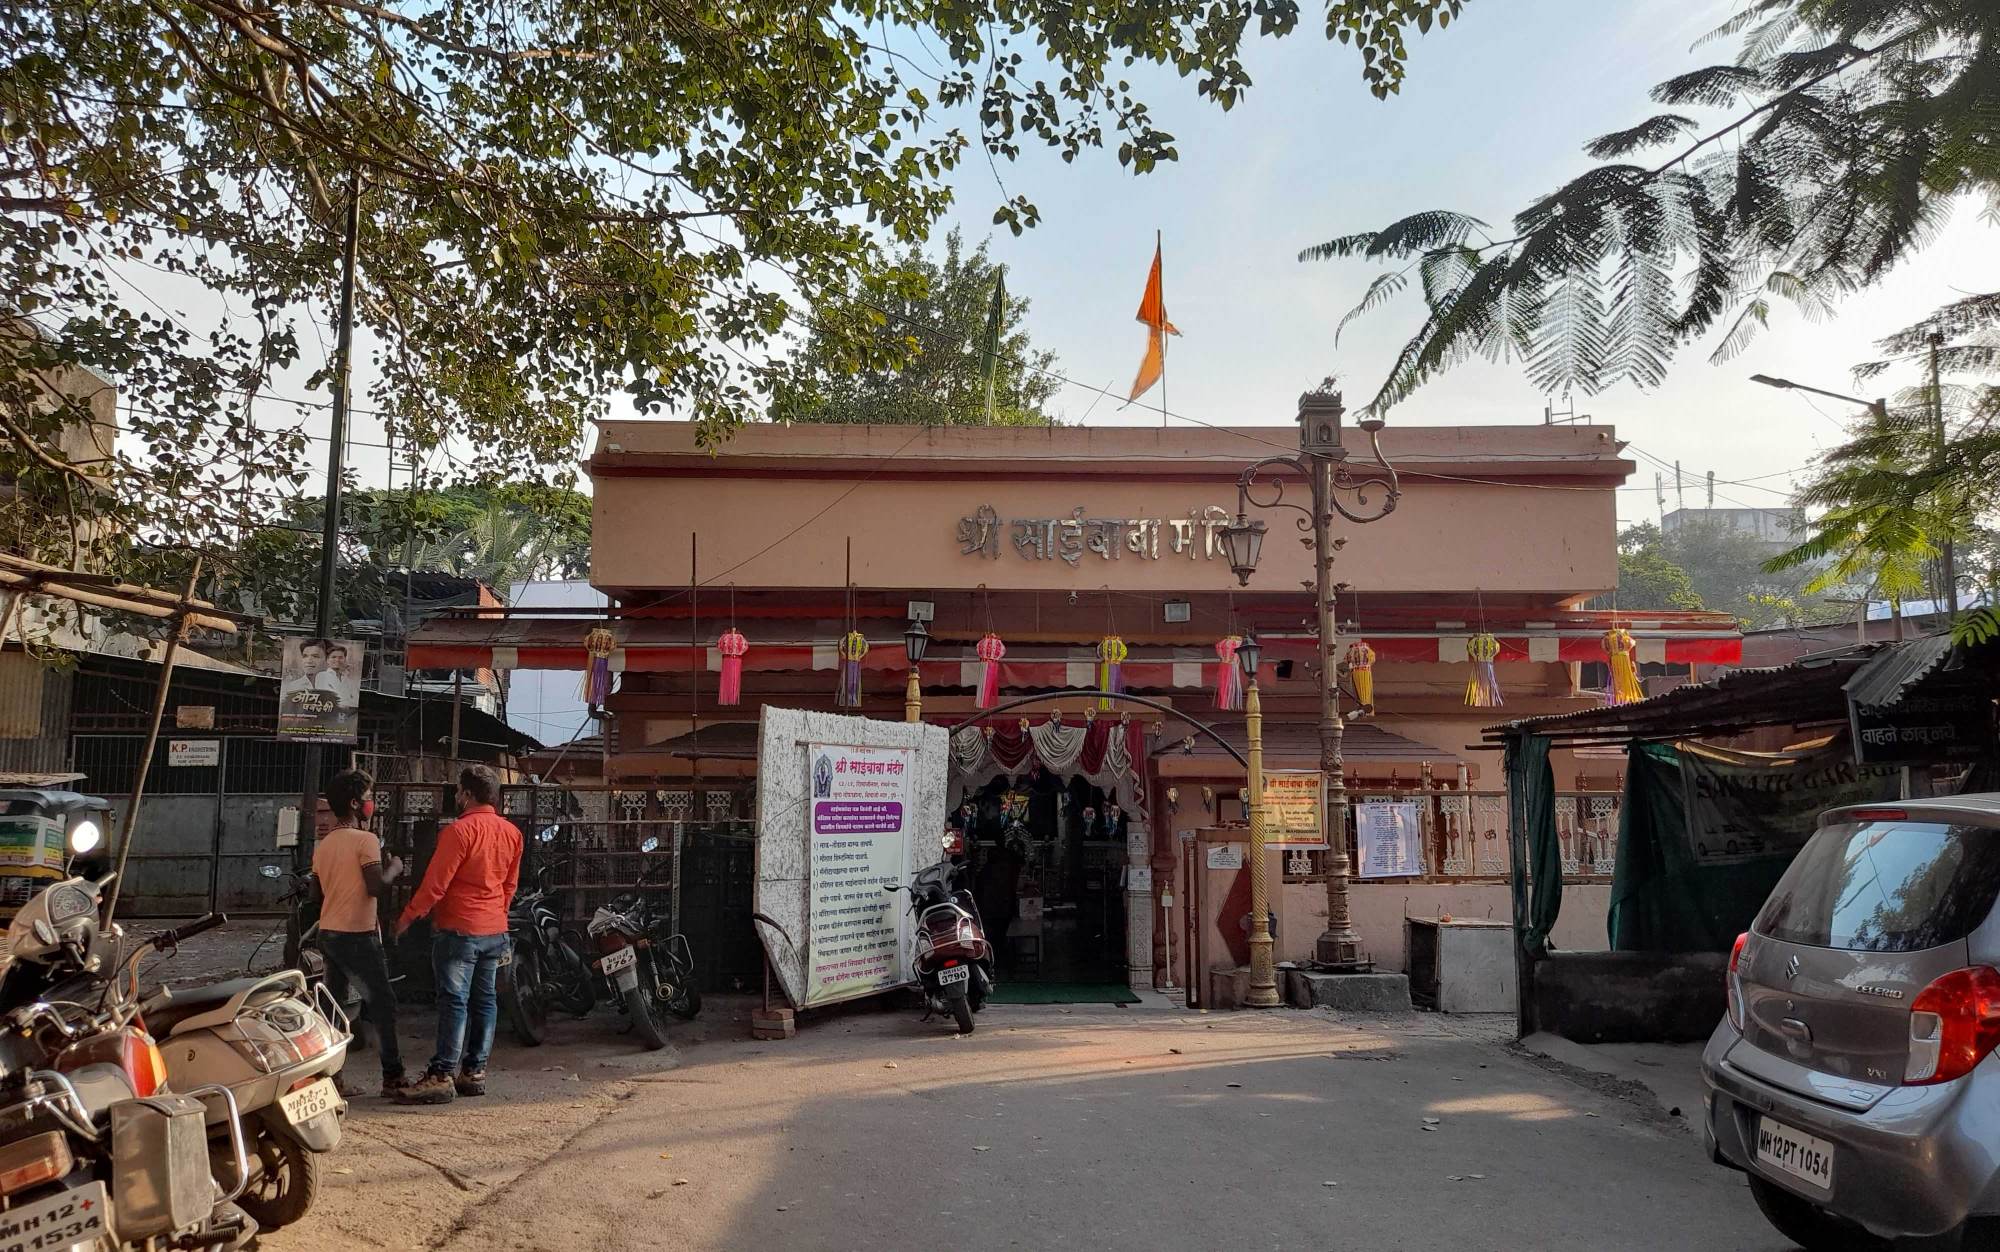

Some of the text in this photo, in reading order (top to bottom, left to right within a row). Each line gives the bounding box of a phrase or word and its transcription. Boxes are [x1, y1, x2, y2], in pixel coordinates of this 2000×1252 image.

[957, 503, 1004, 560] श्री
[1011, 505, 1162, 568] साईबाबा
[835, 757, 847, 774] श्री
[942, 971, 966, 983] 3790
[1856, 985, 1904, 999] CELERIO
[295, 1098, 326, 1120] 1109
